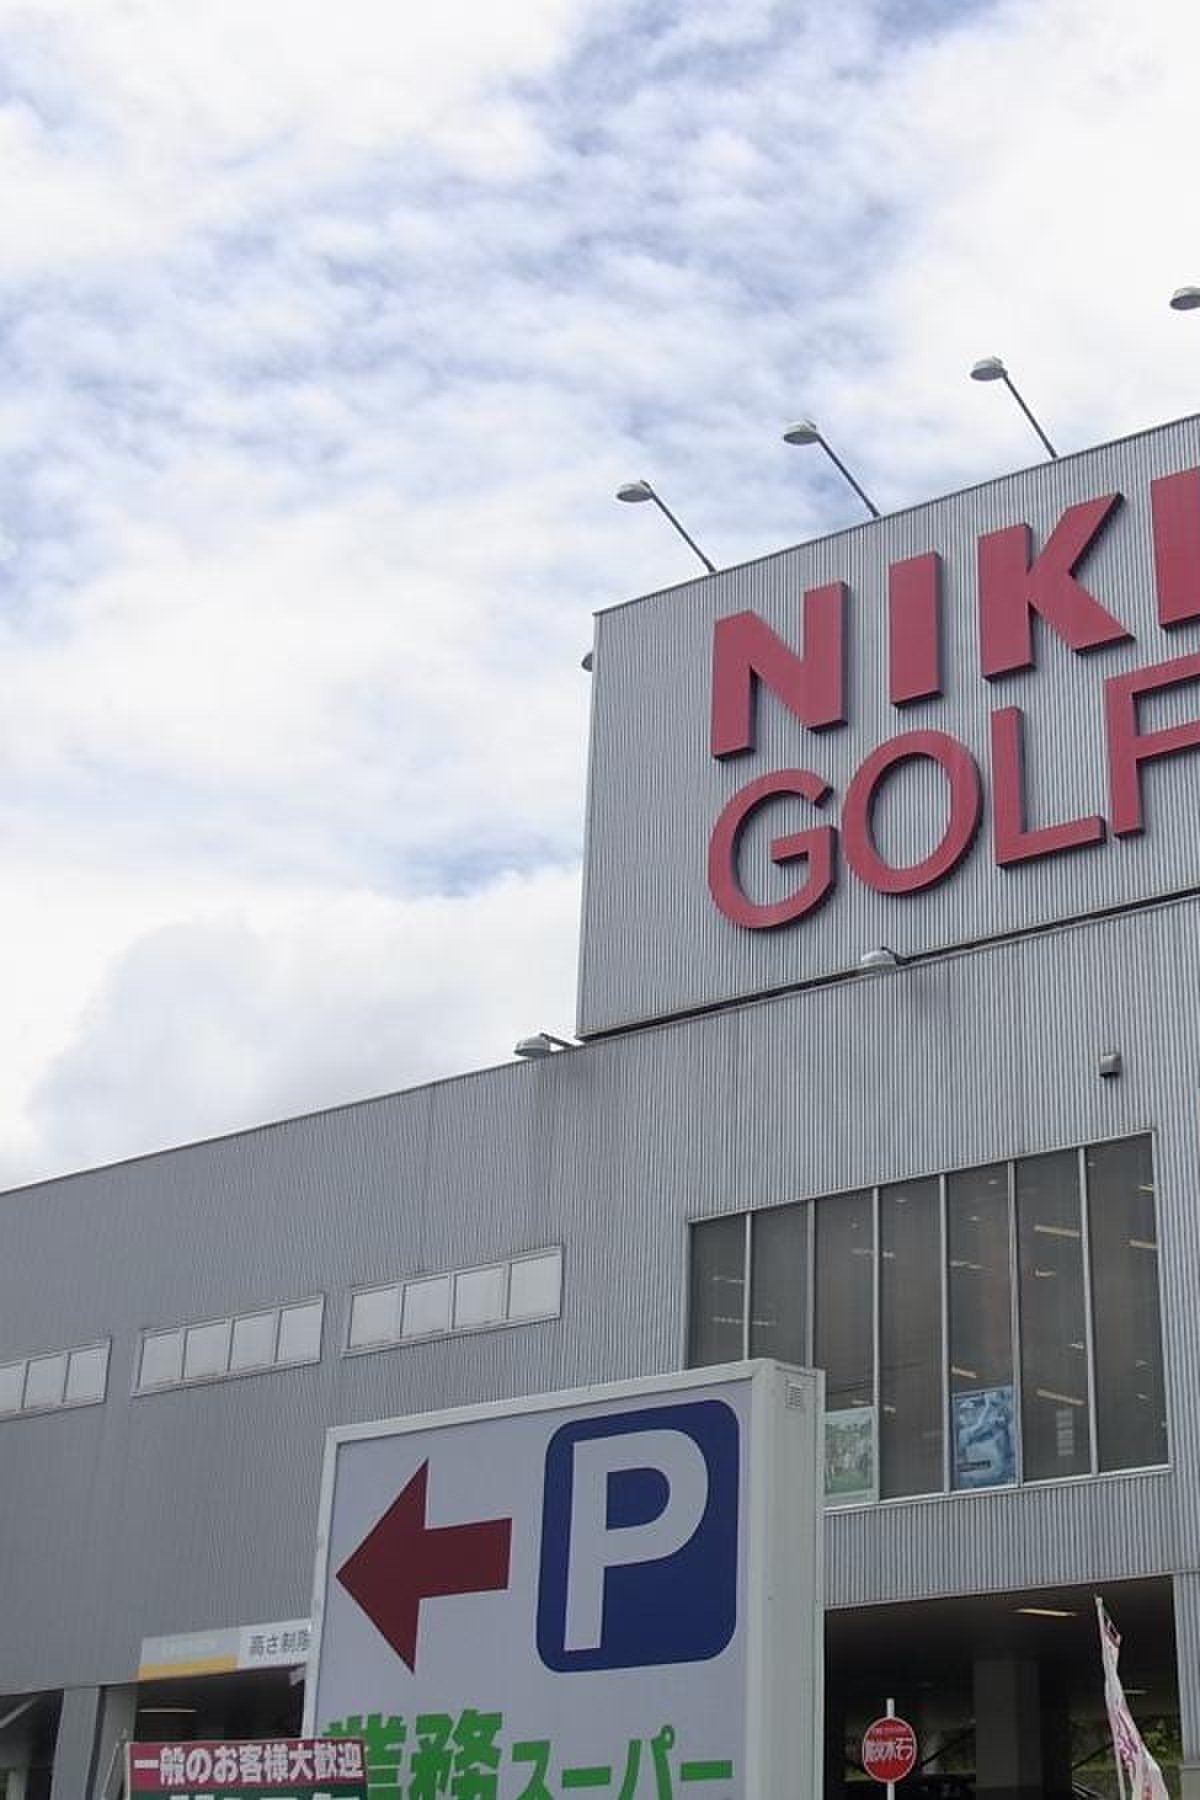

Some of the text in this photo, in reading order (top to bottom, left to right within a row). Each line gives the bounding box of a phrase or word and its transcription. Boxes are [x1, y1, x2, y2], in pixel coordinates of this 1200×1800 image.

[563, 1428, 709, 1652] P
[134, 1741, 364, 1786] 一般のお客様大歓迎
